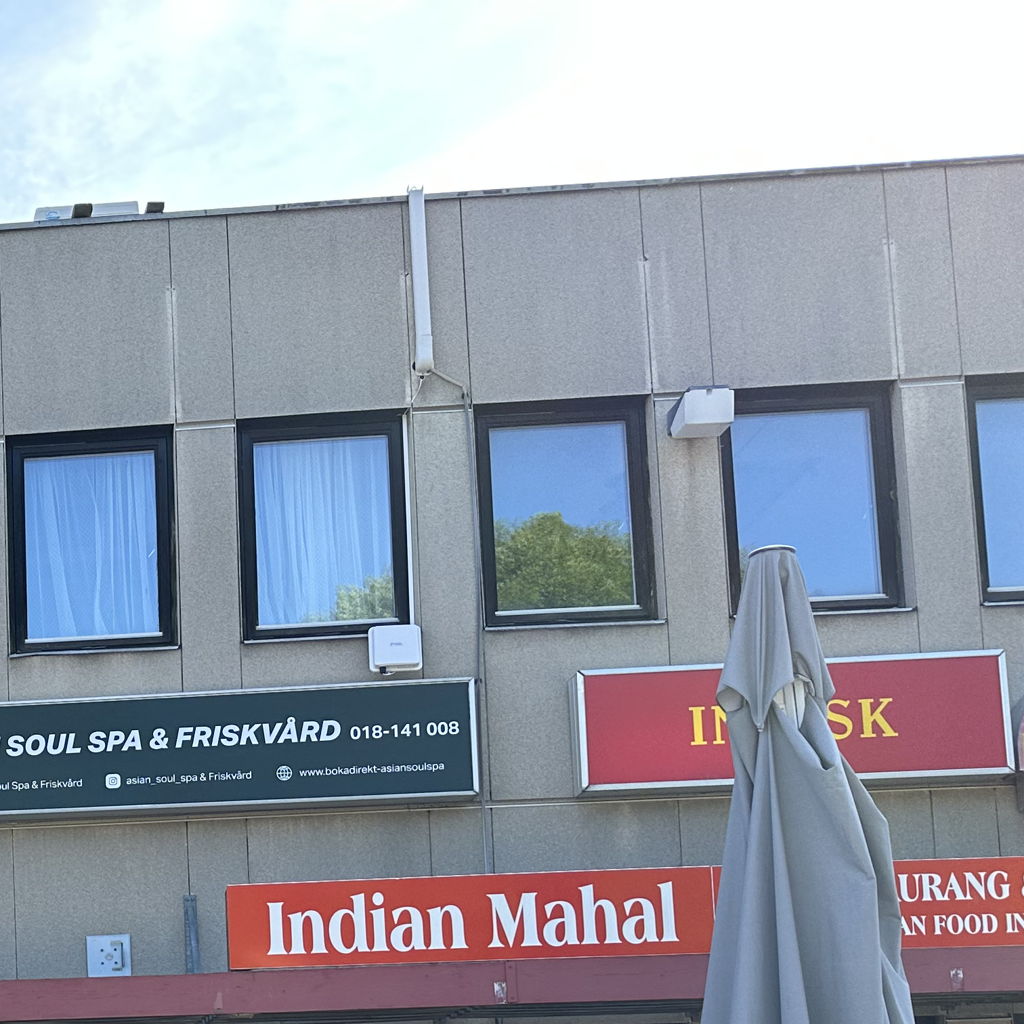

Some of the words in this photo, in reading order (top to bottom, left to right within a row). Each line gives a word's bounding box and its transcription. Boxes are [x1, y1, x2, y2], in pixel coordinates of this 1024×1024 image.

[6, 732, 82, 757] SOUL
[88, 729, 143, 753] SPA
[149, 727, 170, 750] &
[175, 716, 342, 750] FRISKVÅRD
[349, 723, 422, 740] 018-141
[426, 720, 460, 736] 008
[199, 772, 207, 782] &
[208, 770, 253, 782] Friskvård
[299, 762, 445, 777] www.bokadirekt-asiansoulspa
[11, 780, 29, 792] Spa
[31, 780, 39, 790] &
[40, 778, 83, 789] Friskvård
[897, 870, 1011, 903] URANG
[266, 891, 470, 957] Indian
[486, 880, 680, 949] Mahal
[933, 913, 999, 935] FOOD
